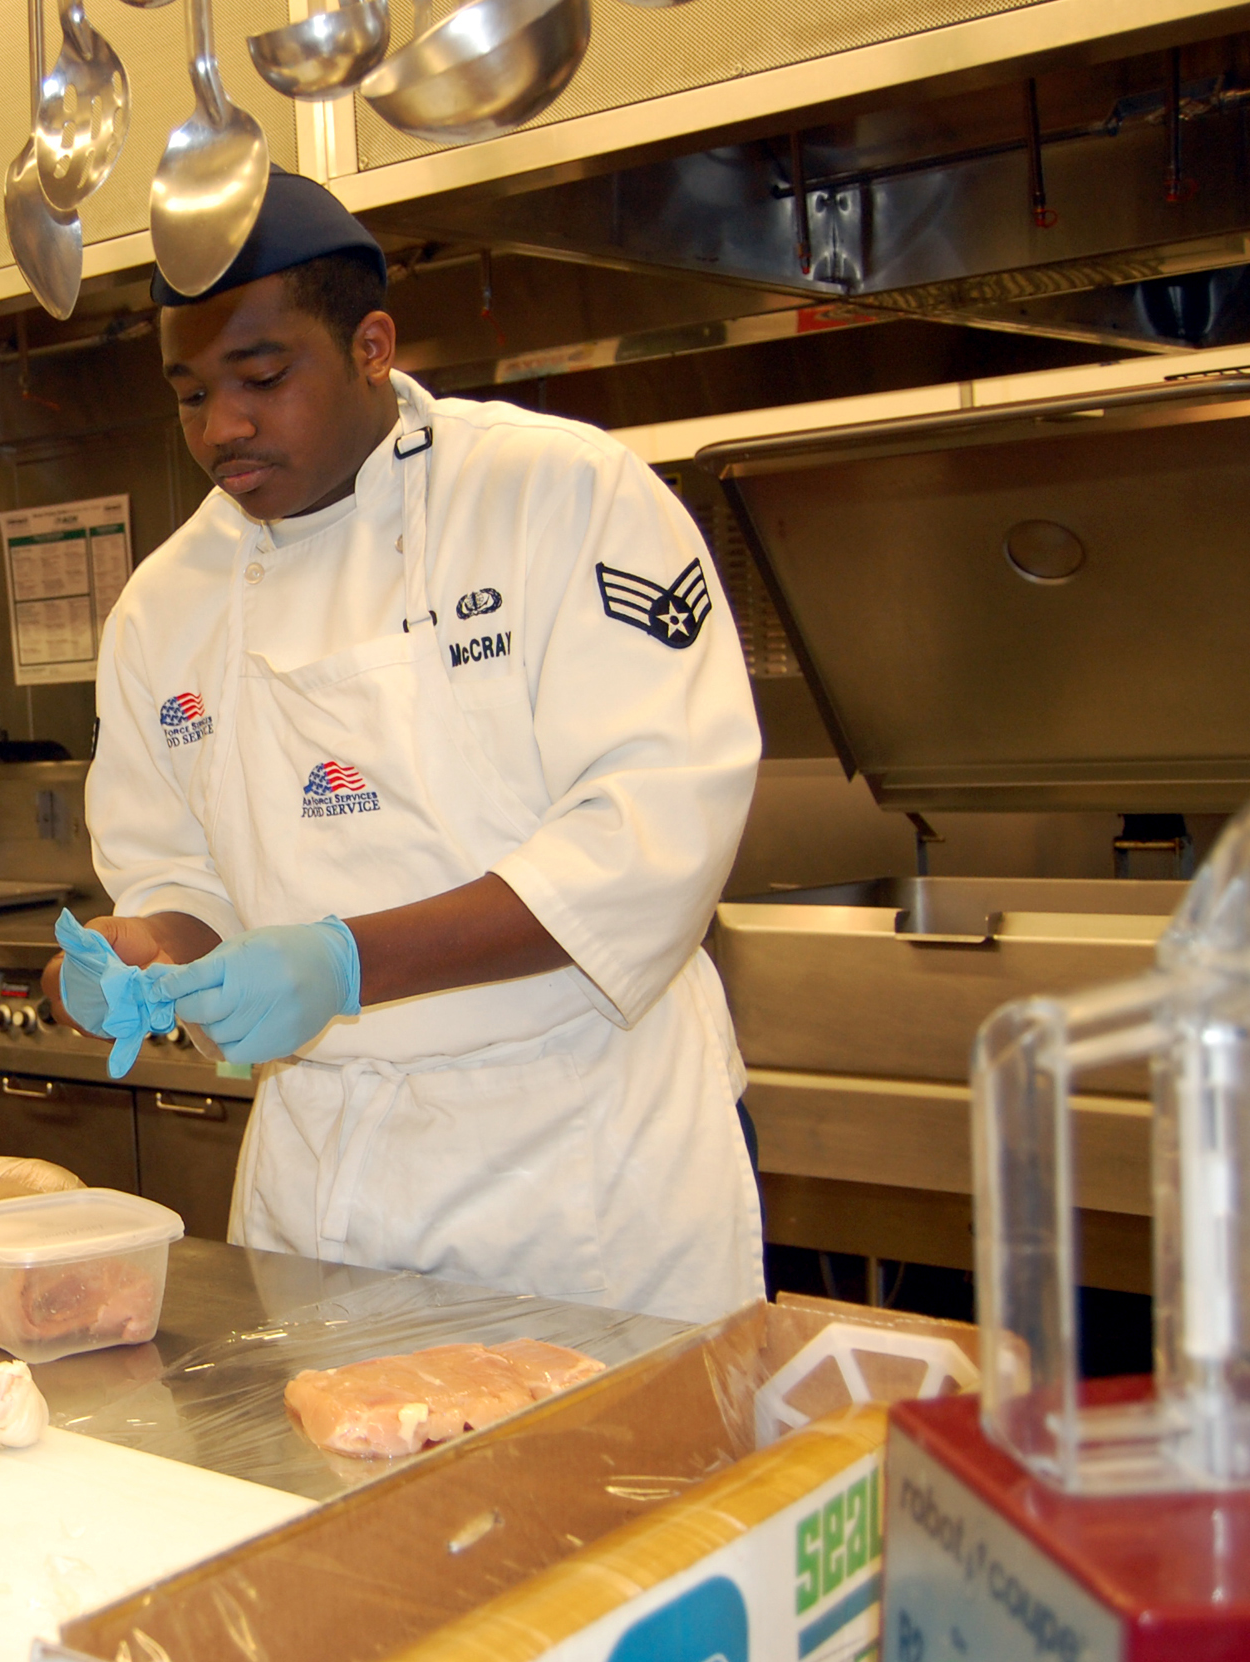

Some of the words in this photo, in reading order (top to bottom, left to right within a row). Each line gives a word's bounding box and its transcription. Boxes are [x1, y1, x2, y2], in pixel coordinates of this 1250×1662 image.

[449, 630, 511, 667] McCRAY
[301, 807, 324, 818] FOOD
[326, 800, 380, 816] SERVICE
